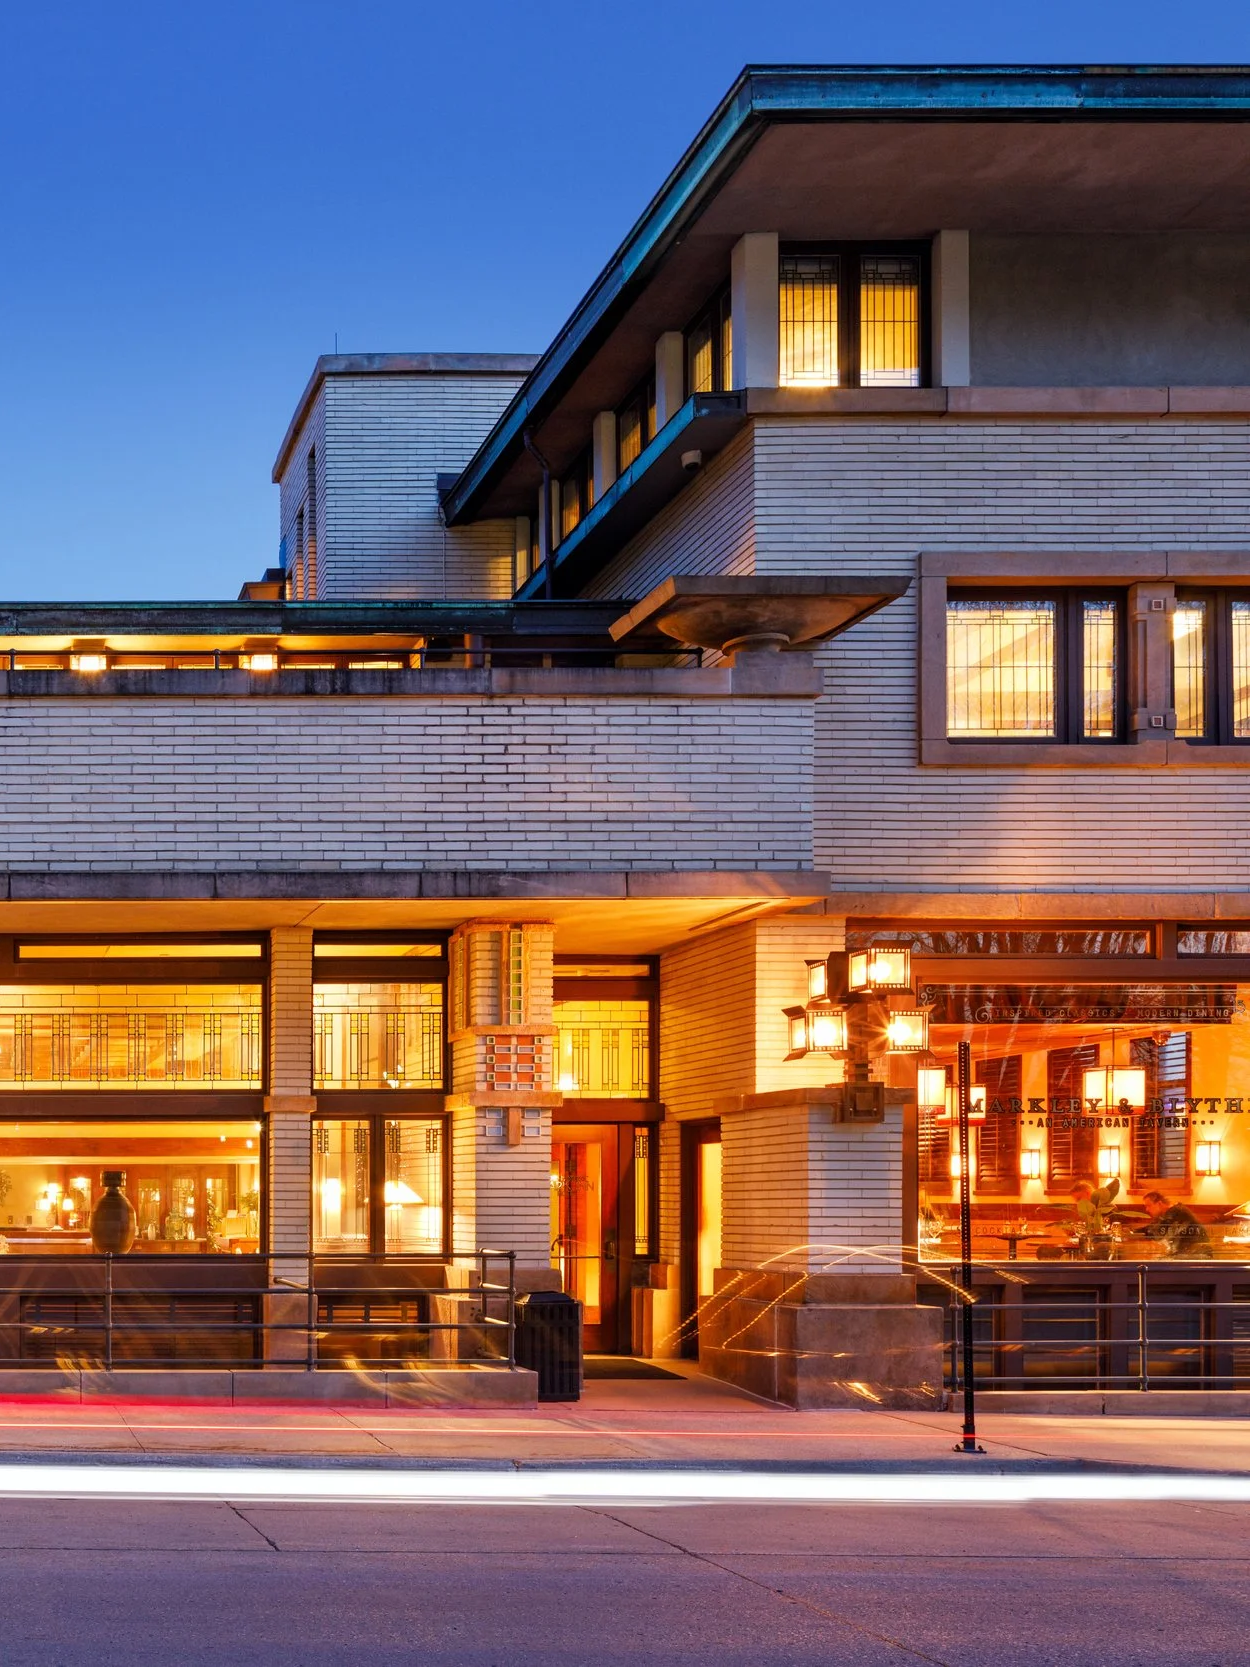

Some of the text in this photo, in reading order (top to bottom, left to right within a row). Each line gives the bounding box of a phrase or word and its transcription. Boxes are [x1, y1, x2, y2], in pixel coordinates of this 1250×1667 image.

[1059, 1008, 1116, 1018] CLASSICS
[1137, 1008, 1180, 1018] MODERN
[1187, 1008, 1230, 1018] DINING
[967, 1097, 1250, 1114] MARKLEY & BLYTH
[1036, 1117, 1190, 1128] AN AMERICAN TAVERN
[1159, 1226, 1216, 1236] SEASONL
